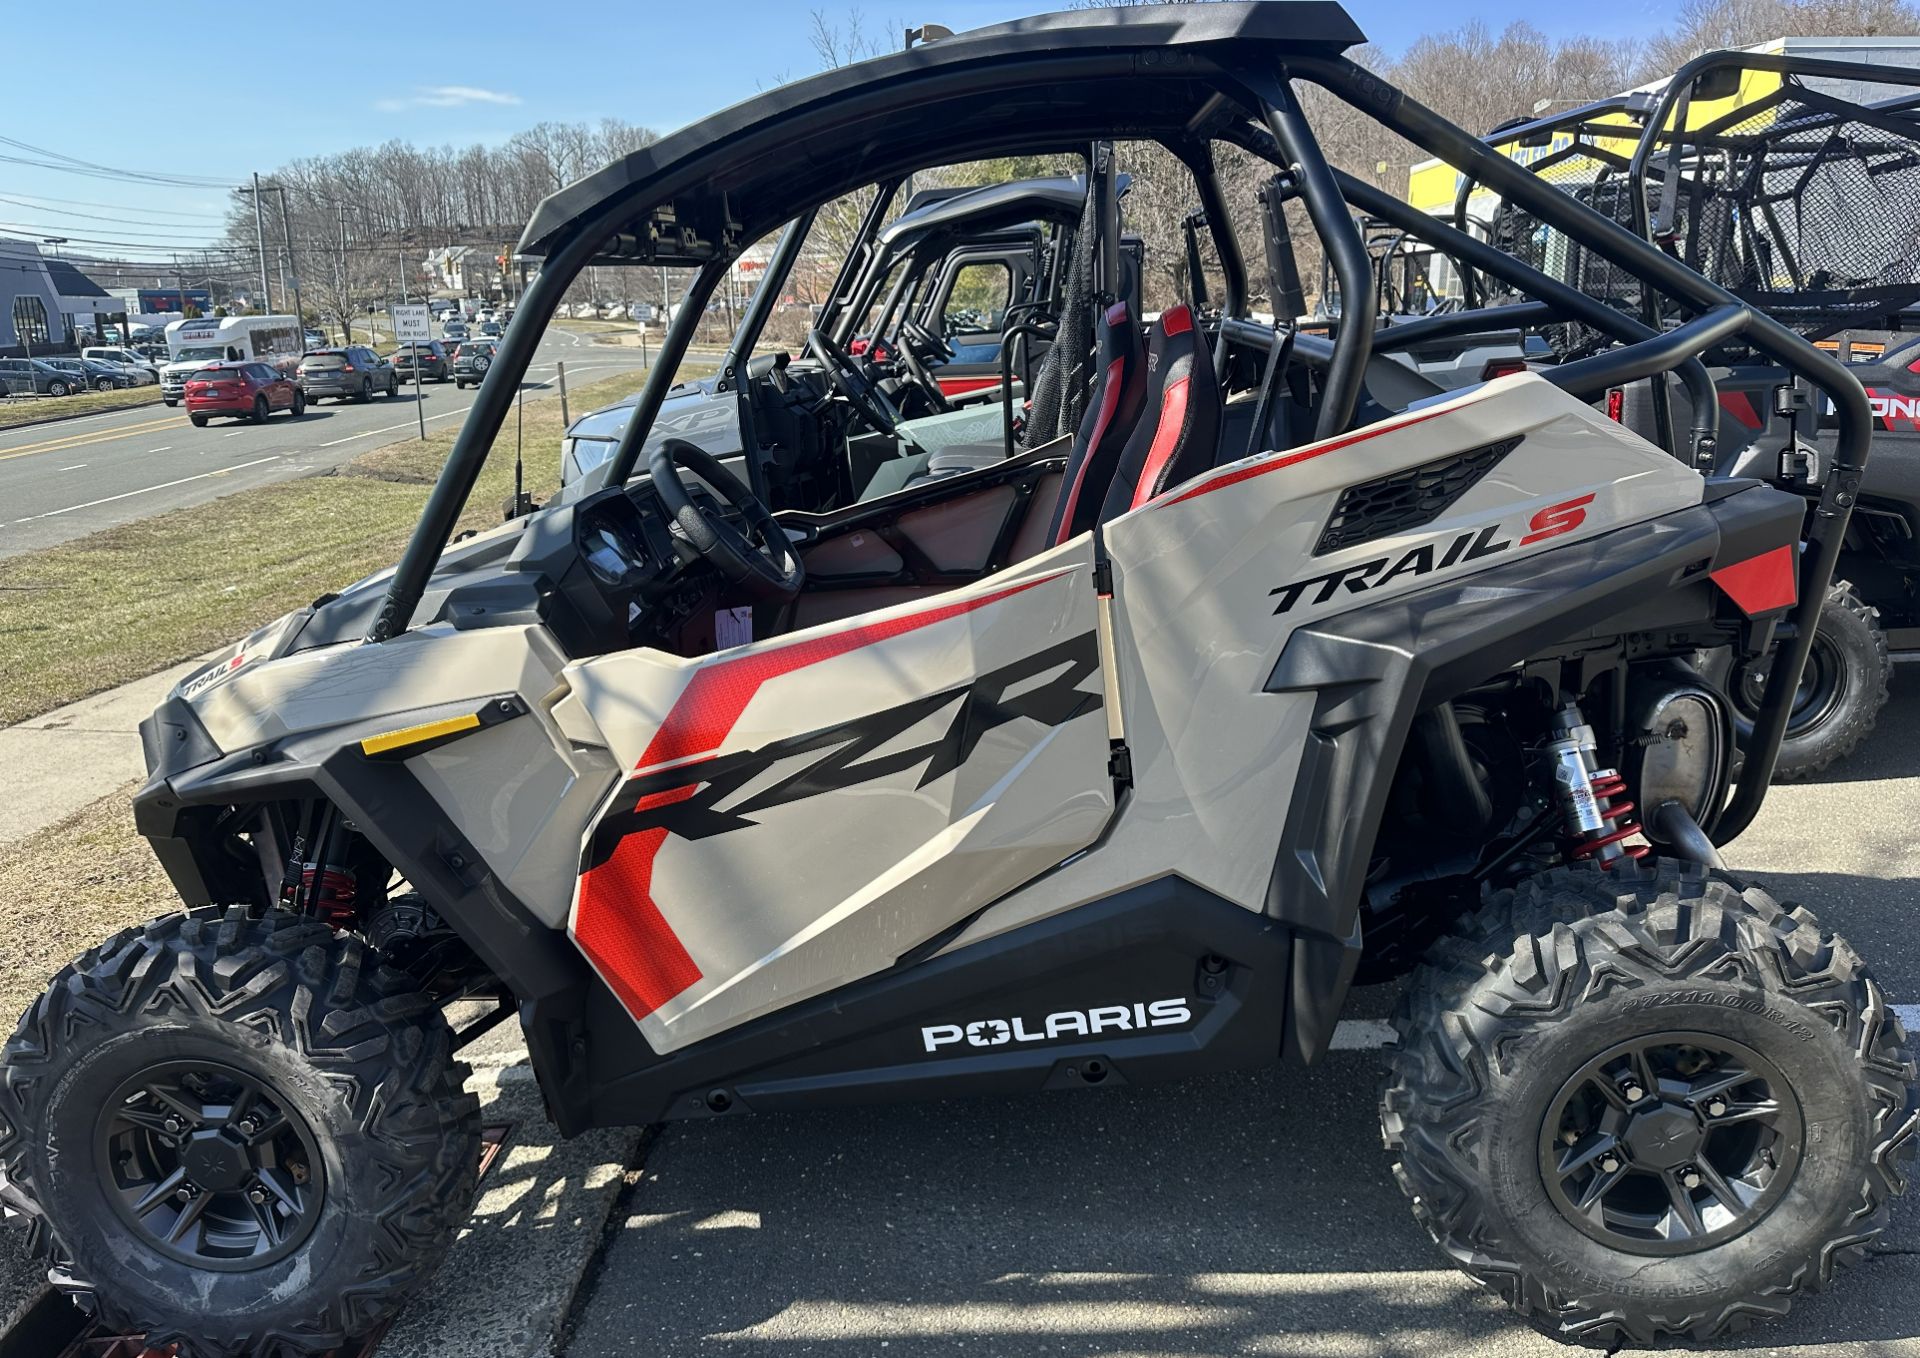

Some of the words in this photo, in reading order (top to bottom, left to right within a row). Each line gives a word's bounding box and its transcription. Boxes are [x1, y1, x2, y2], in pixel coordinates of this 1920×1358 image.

[402, 319, 420, 327] MUST
[649, 406, 730, 439] XP
[1268, 524, 1511, 616] TRAIL
[1519, 492, 1596, 547] S
[185, 664, 228, 696] TRAIL
[228, 654, 245, 671] S
[580, 629, 1104, 876] RZR
[921, 997, 1192, 1053] POLARIS
